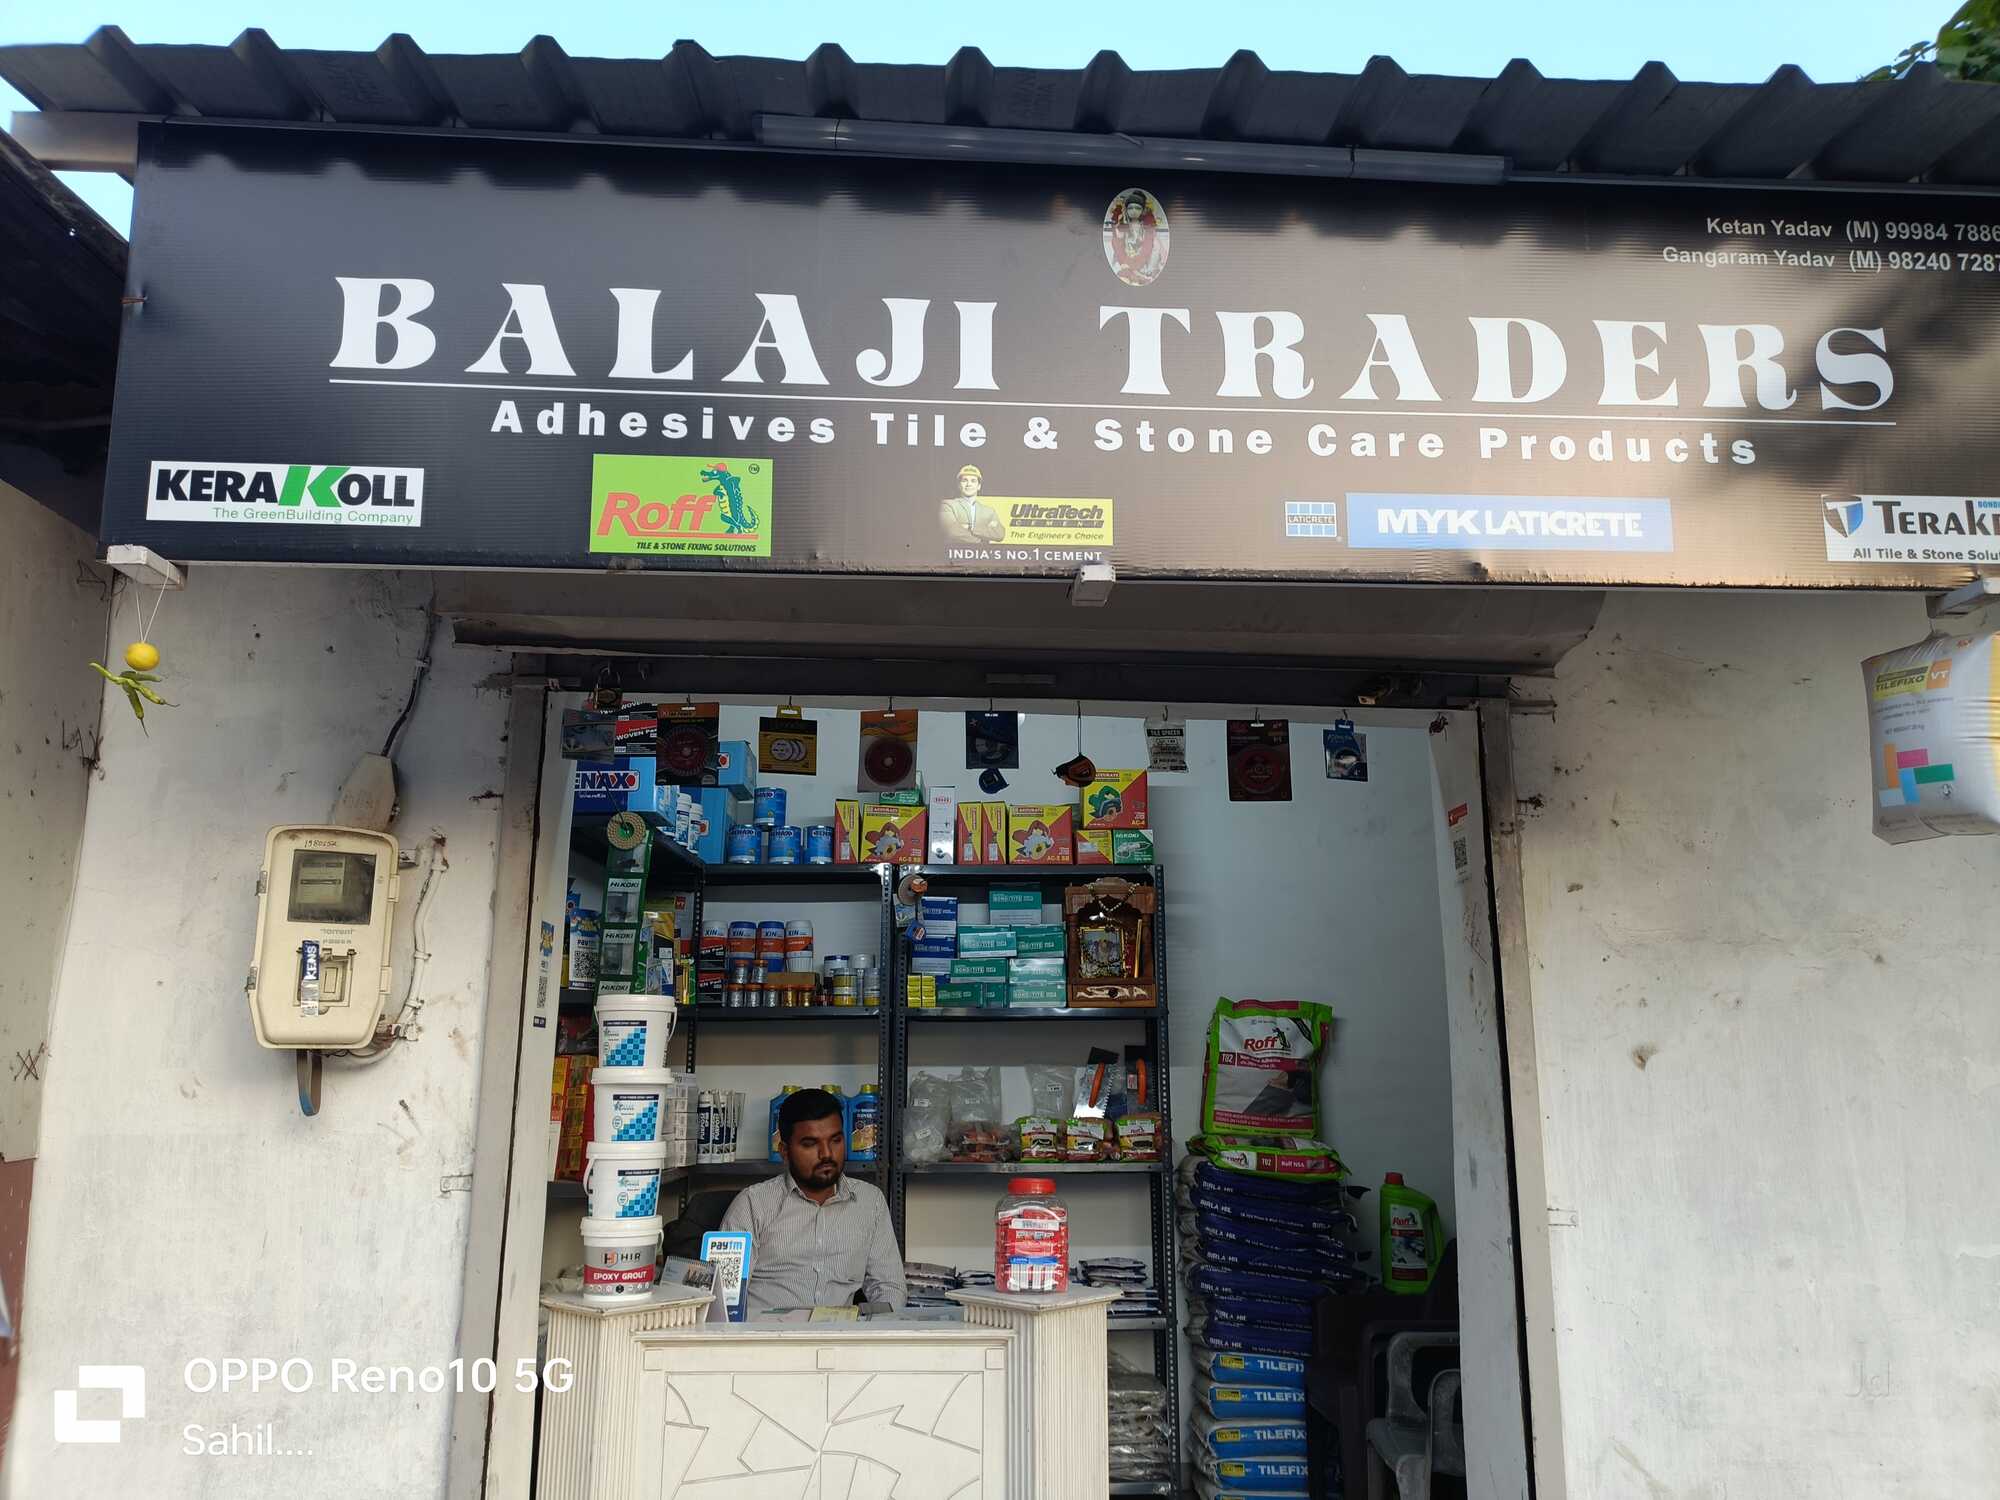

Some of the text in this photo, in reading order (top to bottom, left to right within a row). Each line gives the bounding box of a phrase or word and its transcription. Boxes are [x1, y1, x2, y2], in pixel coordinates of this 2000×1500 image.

[1707, 217, 1765, 235] Ketan
[1771, 219, 1832, 237] Yadav
[1846, 220, 1879, 243] (M)
[1885, 222, 1948, 241] 99984
[1662, 246, 1768, 267] Gangaram
[1773, 249, 1835, 268] Yadav
[1849, 249, 1881, 272] (M)
[1888, 251, 1951, 271] 98240
[330, 276, 1895, 412] BALAJI TRADERS
[490, 400, 1757, 465] Adhesives Tile & Stone Care Products
[156, 465, 415, 507] KERAKOLL
[213, 508, 413, 525] The GreenBuilding Company
[597, 492, 717, 536] Roff
[1010, 504, 1104, 519] UltraTech
[1288, 515, 1336, 524] LATICRETE
[1377, 508, 1644, 537] MYK LATICRETE
[1010, 531, 1104, 541] The Engineer's Choice
[653, 542, 659, 550] &
[660, 543, 686, 551] STONE
[687, 543, 713, 551] FIXING
[714, 544, 757, 552] SOLUTIONS
[948, 548, 1103, 561] INDIA'S NO.1 CEMENT
[1853, 548, 1871, 559] All
[1876, 548, 1901, 559] Tile
[1907, 549, 1918, 560] &
[1922, 549, 1963, 560] Stone
[1931, 670, 1948, 680] VT
[304, 945, 318, 980] KENS
[1243, 1036, 1278, 1051] Roff
[710, 1240, 743, 1251] paytm
[620, 1252, 641, 1261] HIR
[594, 1270, 647, 1281] EPOXY GROUT
